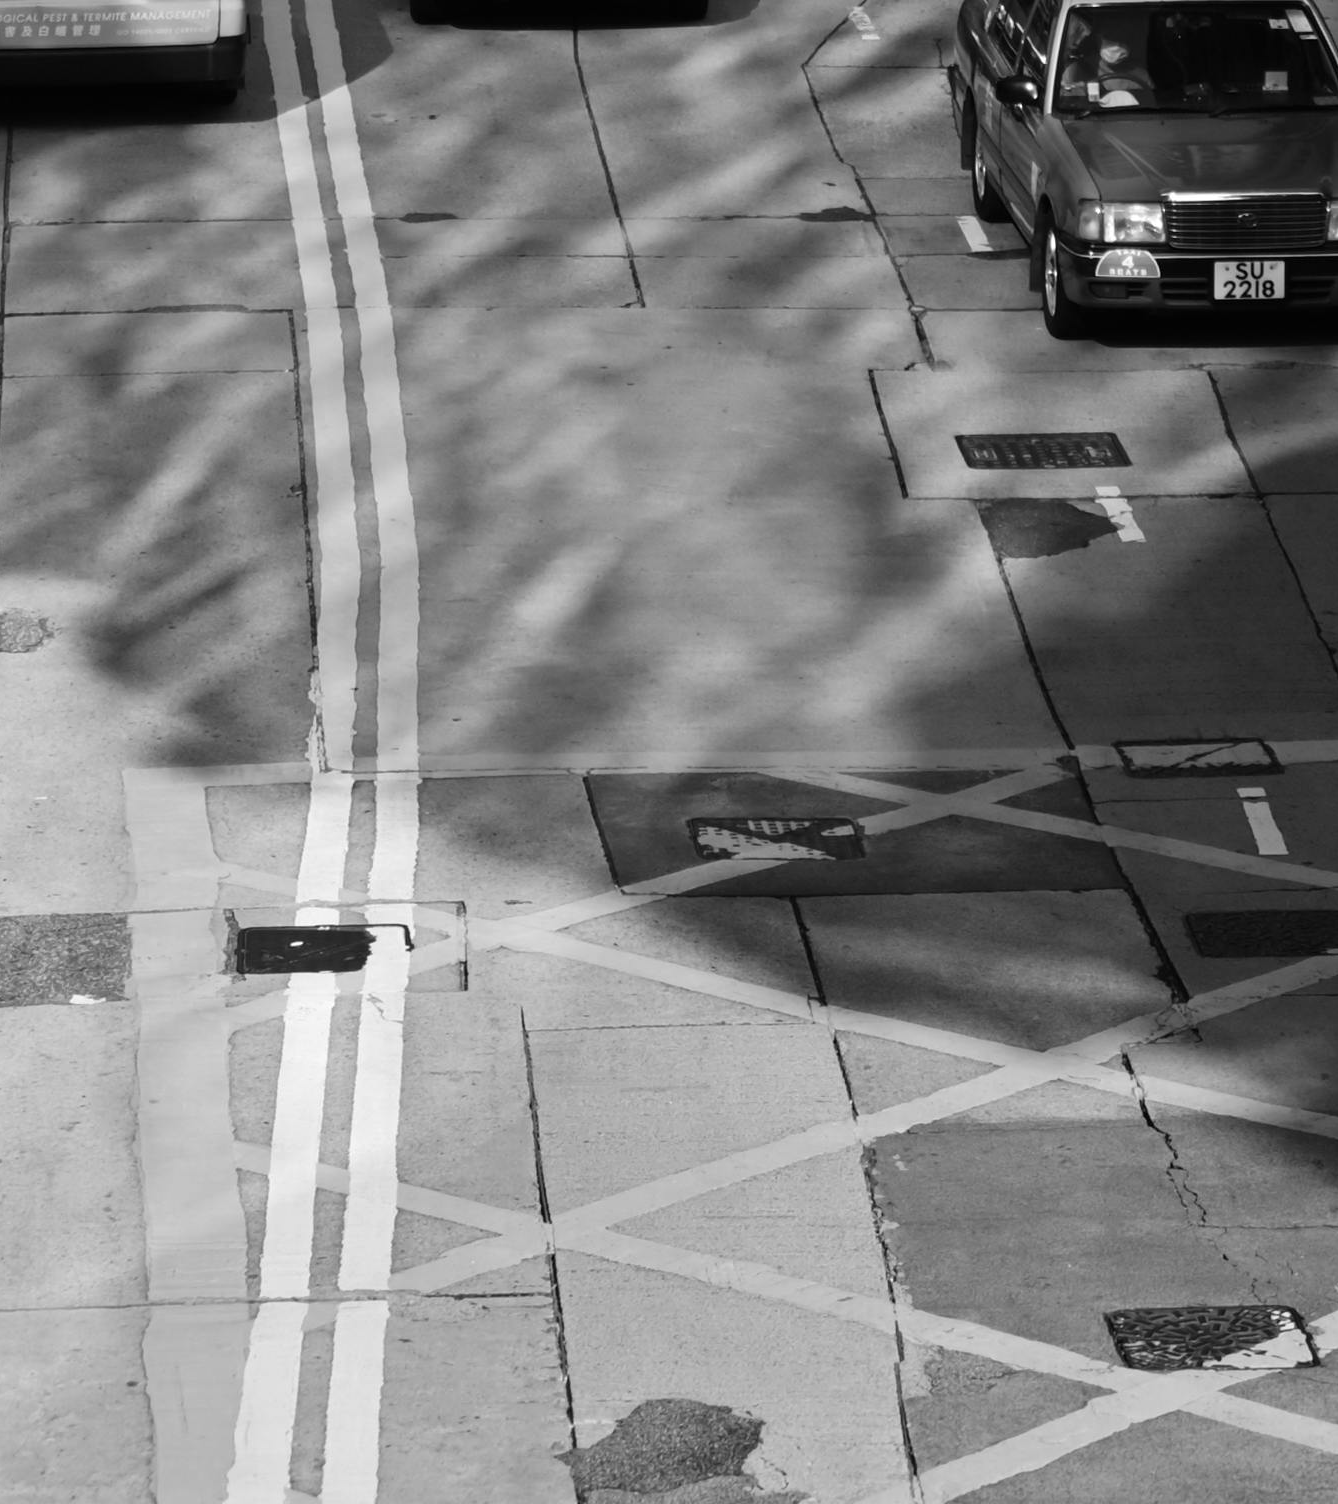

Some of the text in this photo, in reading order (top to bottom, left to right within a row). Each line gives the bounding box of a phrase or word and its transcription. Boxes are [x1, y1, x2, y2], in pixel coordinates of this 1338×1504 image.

[42, 12, 68, 22] PEST
[83, 11, 127, 22] TERMITE
[130, 8, 212, 21] MANAGEMENT
[1122, 256, 1135, 269] 4
[1235, 262, 1265, 281] SU
[1223, 280, 1276, 299] 2218
